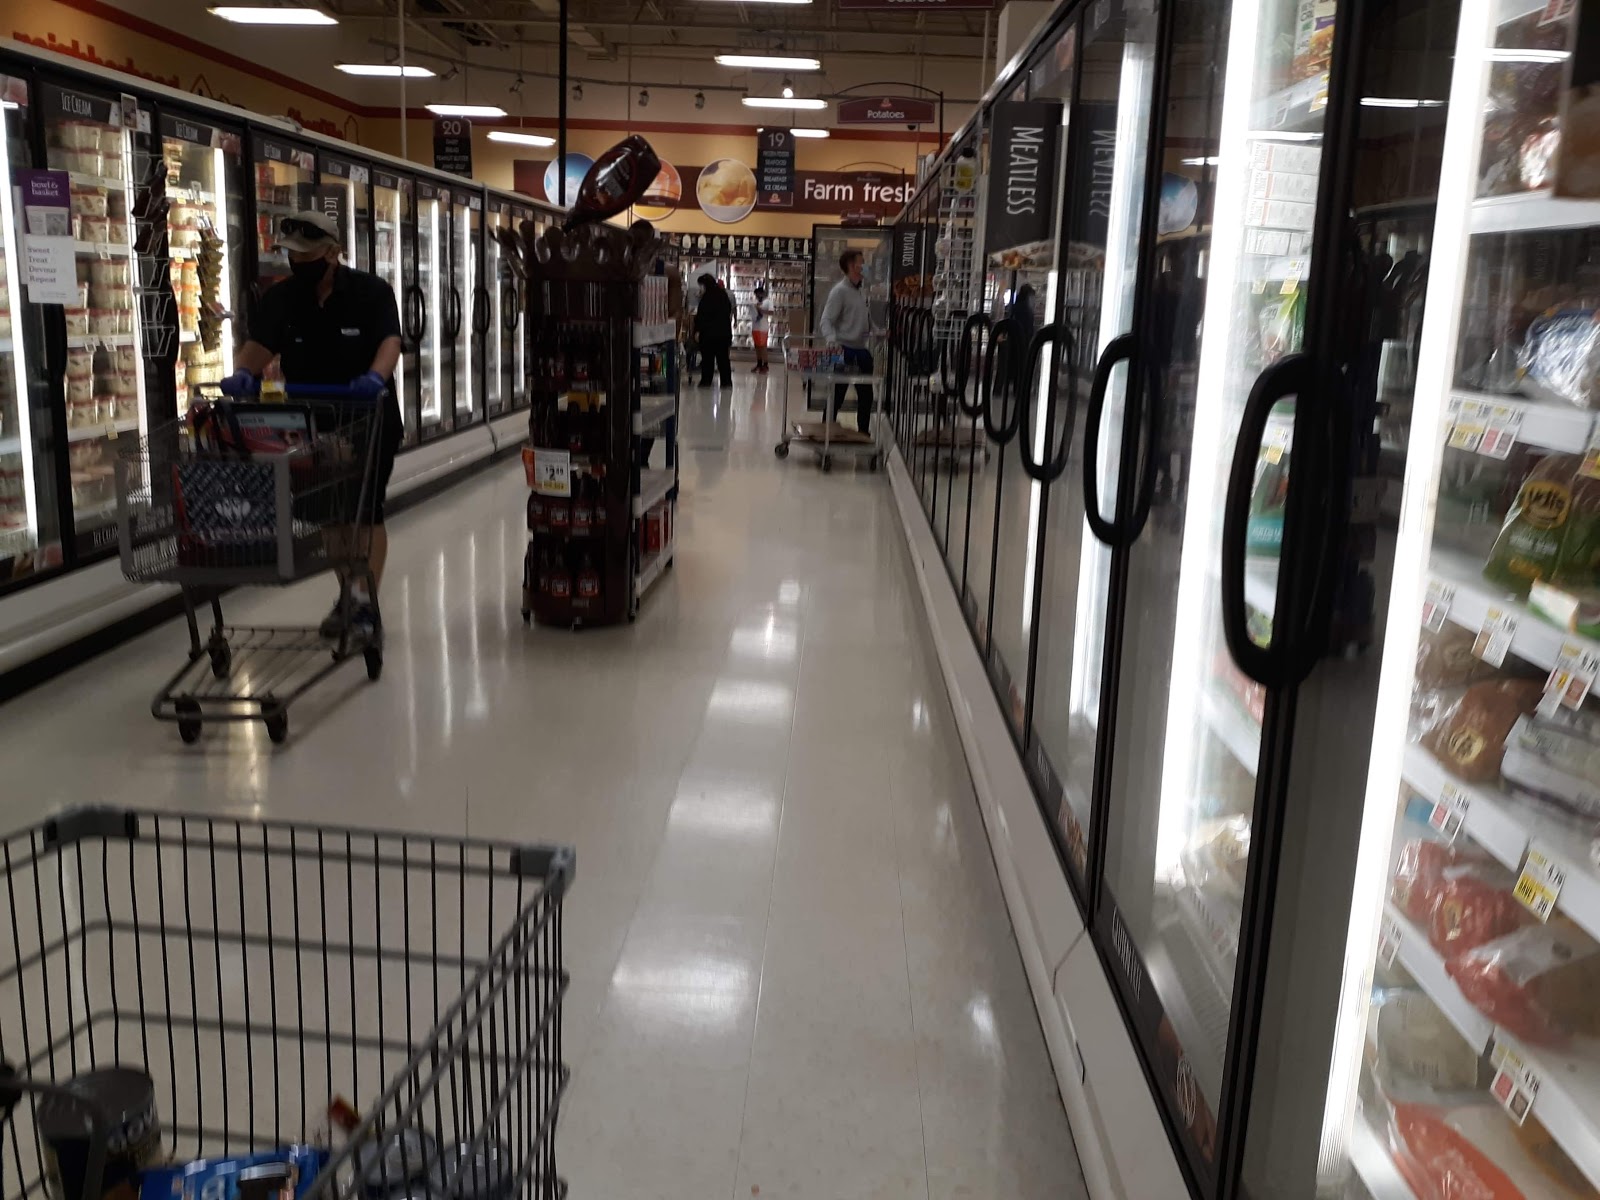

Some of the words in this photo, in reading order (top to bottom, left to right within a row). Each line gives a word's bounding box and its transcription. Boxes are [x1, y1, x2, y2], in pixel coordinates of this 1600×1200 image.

[61, 92, 71, 111] ICE
[72, 95, 92, 117] CREAM
[867, 110, 905, 119] Potatoes
[442, 120, 462, 135] 20
[768, 132, 785, 147] 19
[1006, 126, 1044, 215] MEATLESS
[31, 180, 50, 188] bowl
[32, 188, 59, 197] basket
[804, 179, 853, 201] Farm
[863, 182, 916, 203] fresh
[324, 196, 338, 208] ICE
[27, 246, 50, 254] Sweet
[902, 232, 917, 267] POTATOES
[28, 256, 48, 264] Treat
[29, 265, 57, 273] Devour
[30, 275, 56, 283] Repeat
